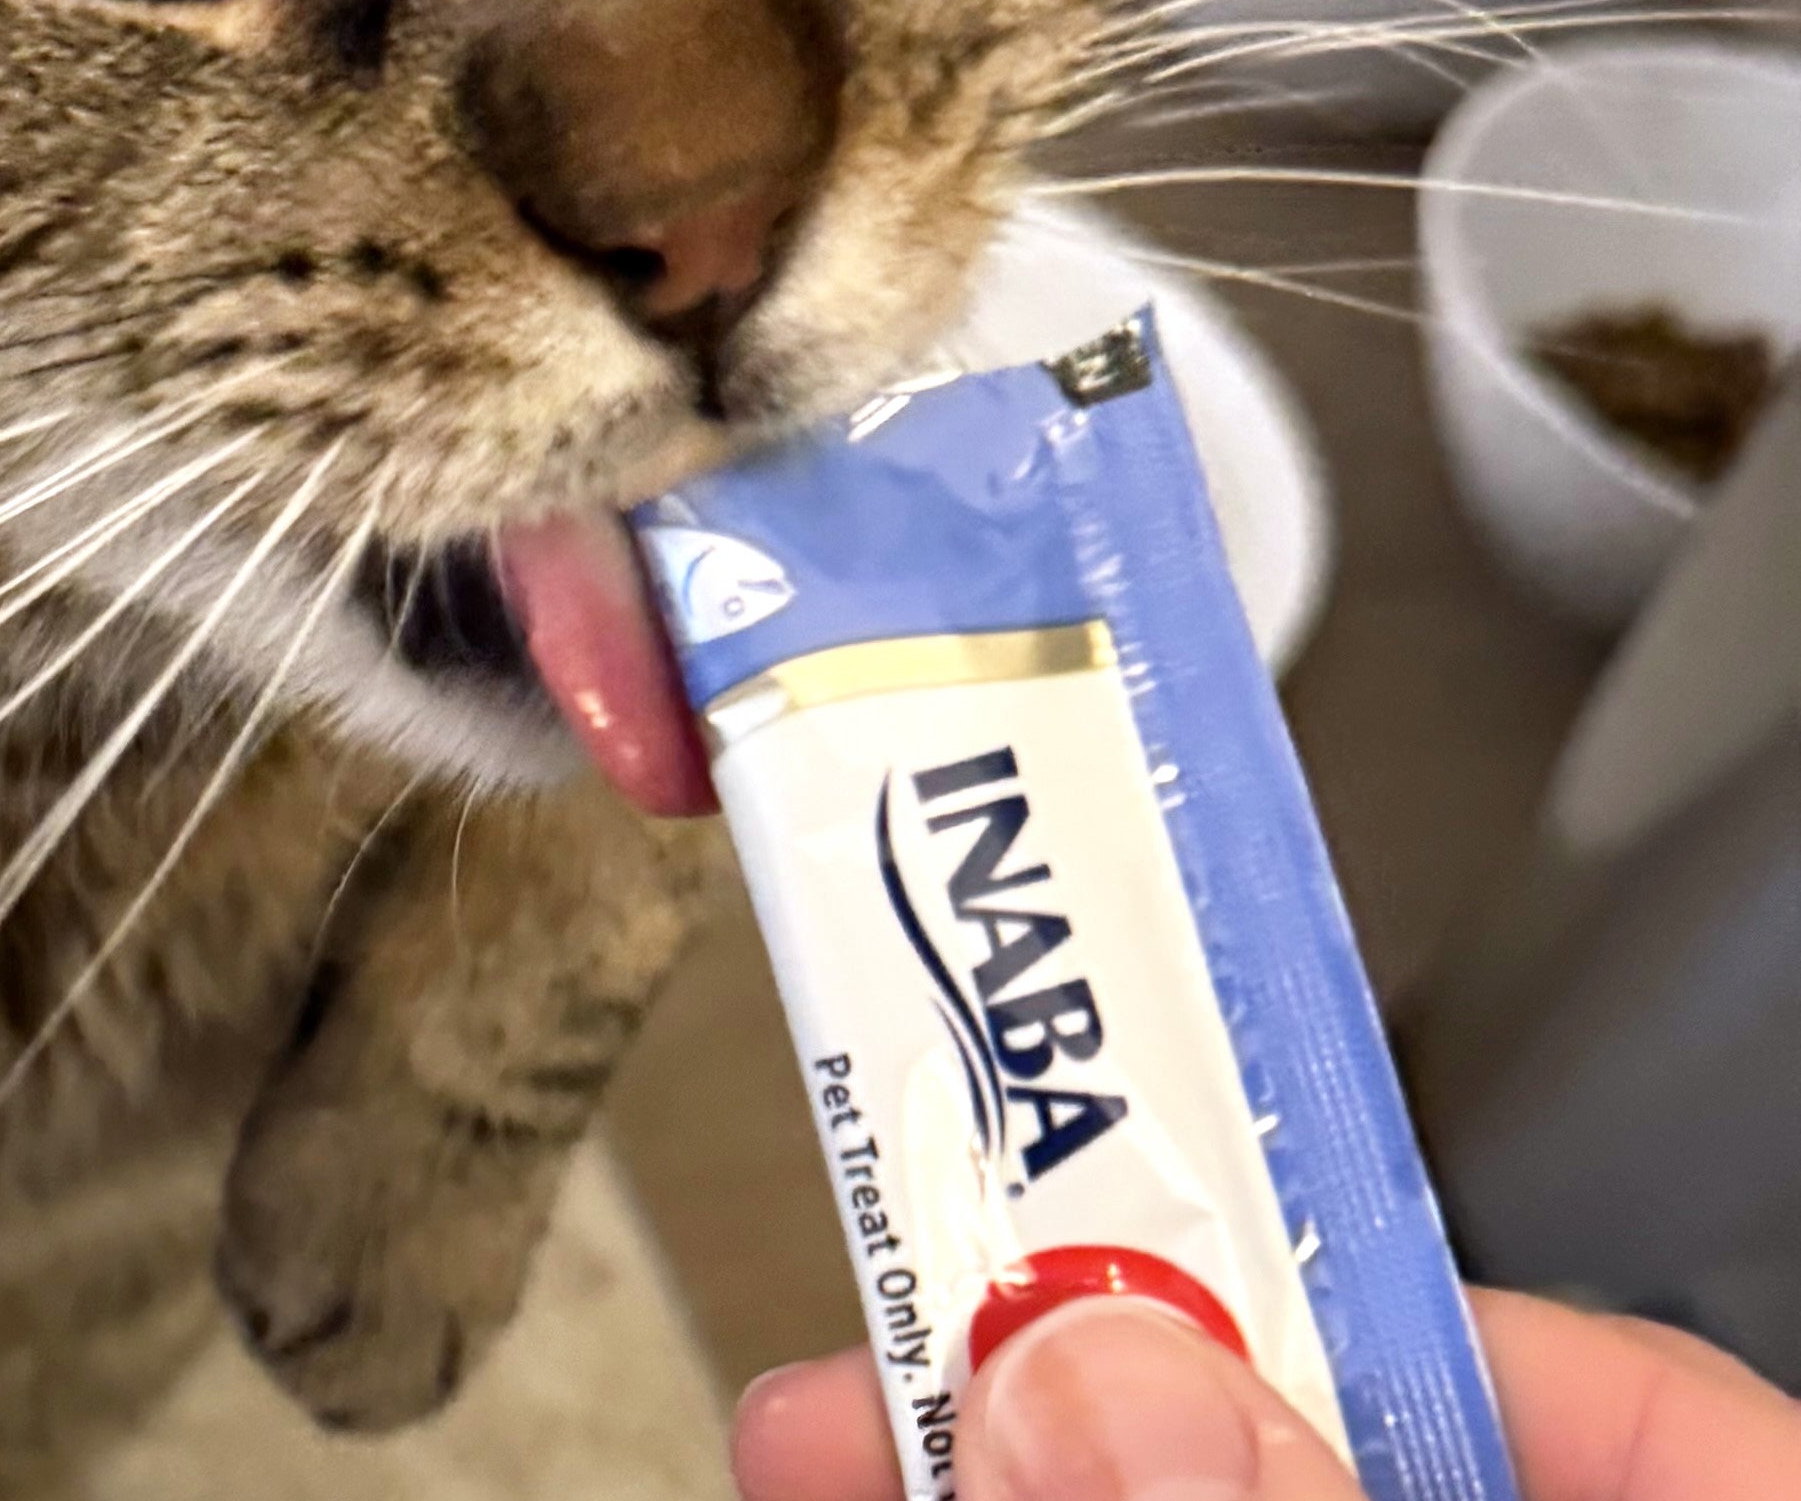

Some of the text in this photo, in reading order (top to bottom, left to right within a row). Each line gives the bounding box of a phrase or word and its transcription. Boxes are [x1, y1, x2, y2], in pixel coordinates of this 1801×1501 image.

[912, 745, 1129, 1182] INABA
[814, 1052, 862, 1131] Pet
[840, 1136, 902, 1257] Treat
[876, 1267, 933, 1383] Only.
